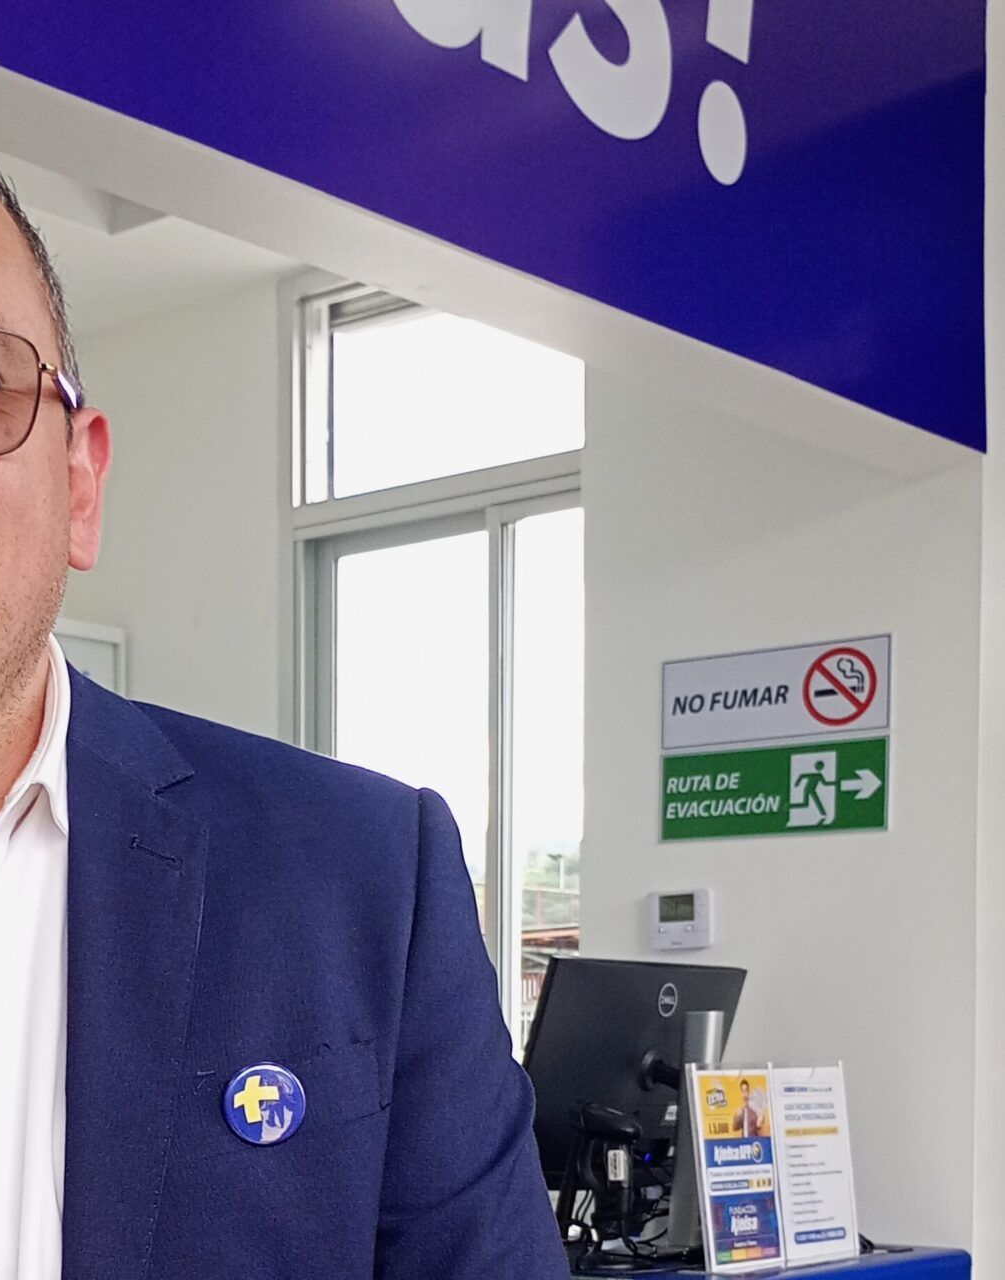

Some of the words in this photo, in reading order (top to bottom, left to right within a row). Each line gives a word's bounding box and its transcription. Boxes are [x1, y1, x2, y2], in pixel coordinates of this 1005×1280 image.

[672, 695, 705, 716] NO
[709, 685, 789, 711] FUMAR
[666, 775, 711, 794] RUTA
[714, 772, 740, 790] DE
[665, 793, 780, 819] EVACUACIÓN
